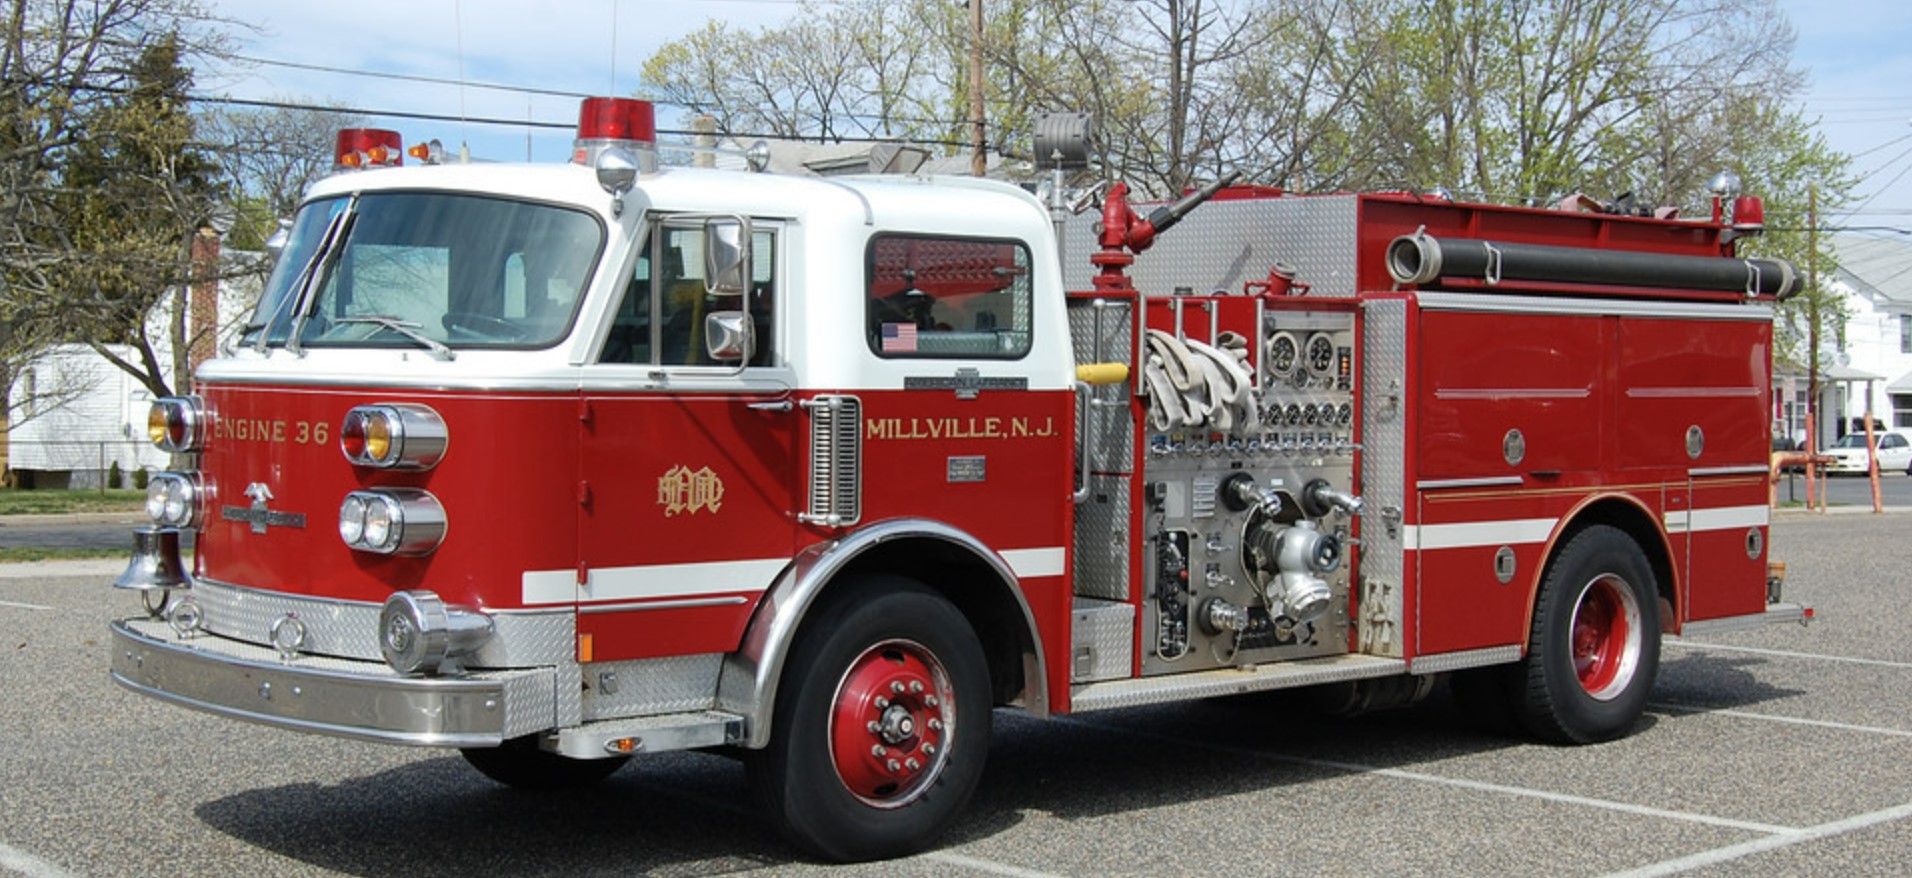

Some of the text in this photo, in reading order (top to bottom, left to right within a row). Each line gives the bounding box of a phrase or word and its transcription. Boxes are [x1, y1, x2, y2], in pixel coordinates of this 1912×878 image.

[215, 418, 329, 445] ENGINE 36
[866, 416, 1059, 440] MILLVILLE, N.J.
